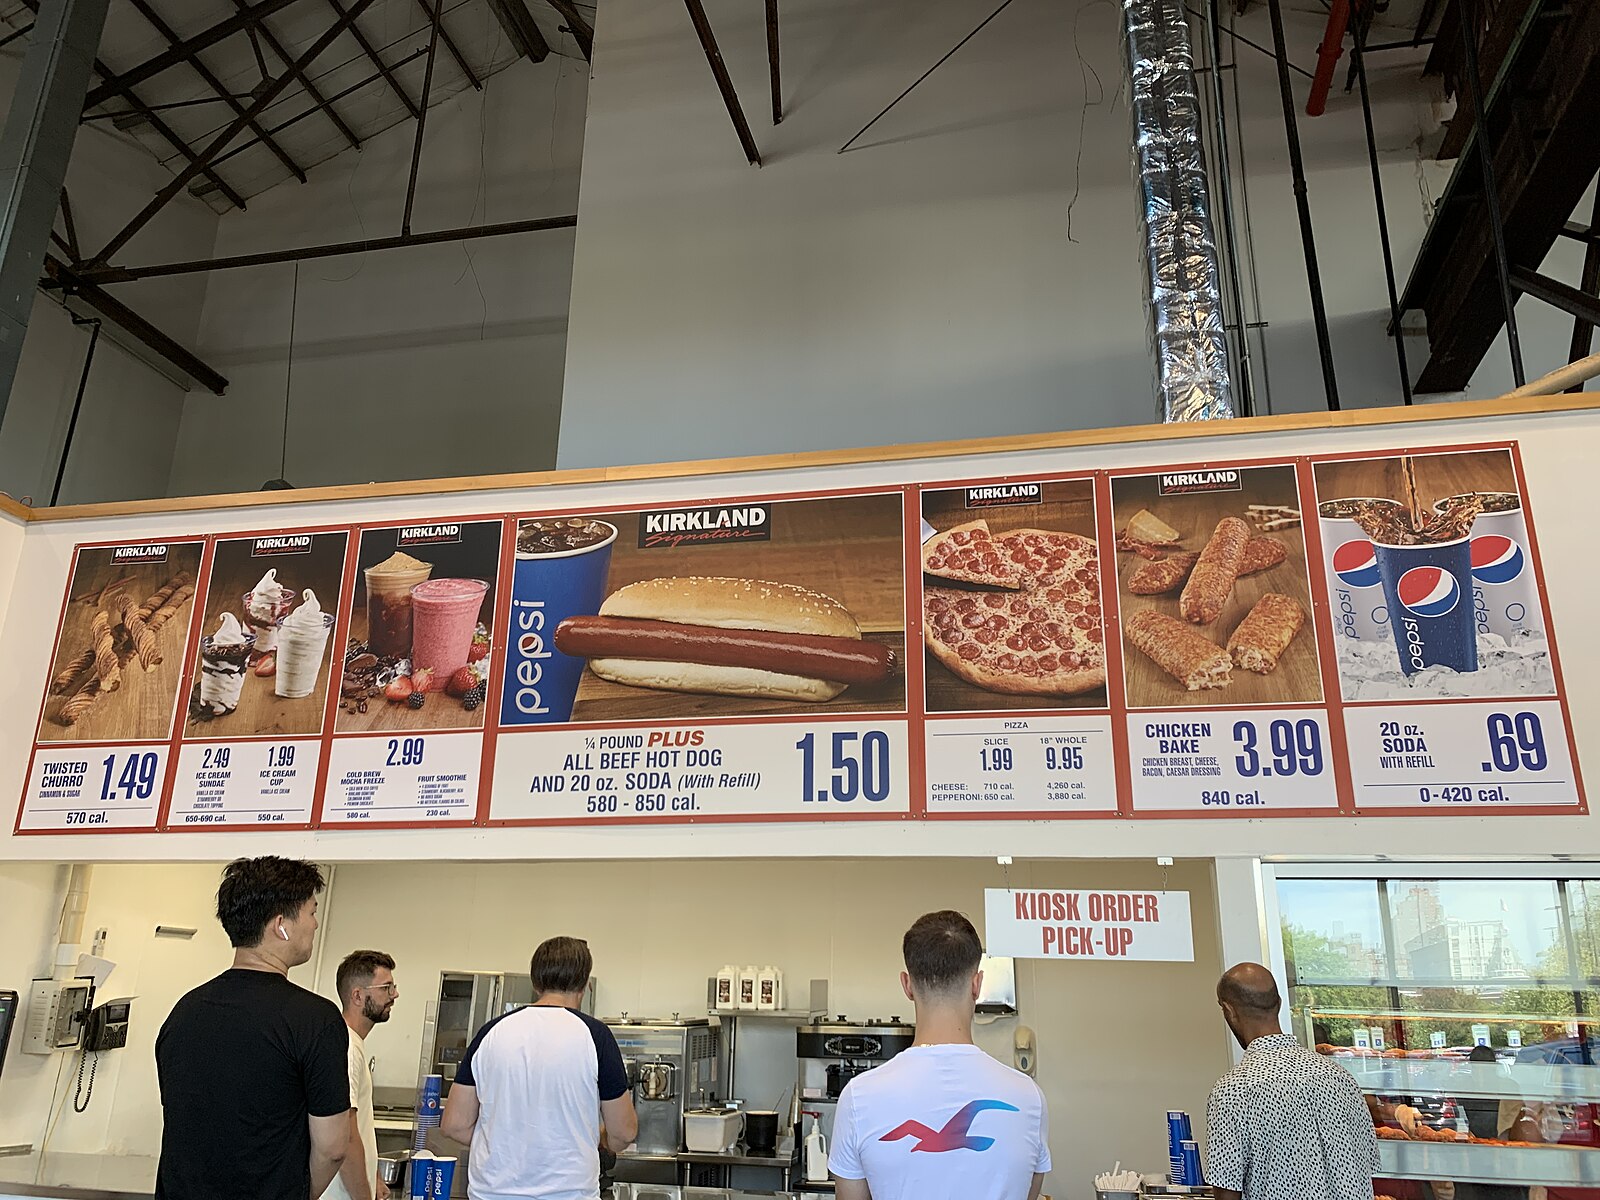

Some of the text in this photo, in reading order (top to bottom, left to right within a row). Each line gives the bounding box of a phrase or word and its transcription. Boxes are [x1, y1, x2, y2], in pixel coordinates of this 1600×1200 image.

[1163, 471, 1237, 486] KIRKLAND
[969, 485, 1039, 499] KIRKLAND
[646, 507, 766, 532] KIRKLAND
[401, 525, 459, 538] KIRKLAND
[645, 529, 765, 547] Signature
[256, 536, 310, 548] KIRKLAND
[115, 546, 166, 557] KIRKLAND
[1335, 588, 1360, 639] pepsi
[1401, 616, 1425, 671] pepsi
[513, 599, 552, 714] pepsi
[1004, 721, 1029, 729] PIZZA
[1145, 723, 1211, 738] CHICKEN
[1379, 721, 1424, 737] 20 oz.
[600, 735, 643, 749] POUND
[647, 730, 705, 748] PLUS
[1055, 736, 1088, 744] WHOLE
[1159, 739, 1200, 754] BAKE
[1383, 738, 1427, 753] SODA
[1481, 711, 1548, 773] .69
[386, 738, 425, 766] 2.99
[1232, 719, 1323, 777] 3.99
[202, 747, 231, 769] 2.49
[268, 746, 295, 767] 1.99
[563, 749, 722, 771] ALL BEEF HOT DOG
[979, 747, 1013, 771] 1.99
[1046, 746, 1083, 770] 9.95
[1142, 756, 1219, 767] CHICKEN BREAST, CHEESE,
[1380, 755, 1435, 769] WITH REFILL
[43, 762, 88, 774] TWISTED
[260, 769, 296, 778] ICE CREAM
[796, 730, 890, 802] 1.50
[1142, 767, 1221, 778] BACON, CAESAR DRESSING
[41, 775, 83, 788] CHURRO
[100, 752, 158, 800] 1.49
[207, 771, 231, 779] CREAM
[436, 774, 467, 782] SMOOTHIE
[530, 772, 761, 793] AND 20 oz. SODA (With Refill)
[199, 780, 225, 788] SUNDAE
[931, 783, 968, 791] CHEESE:
[1000, 782, 1014, 790] cal.
[1046, 782, 1069, 790] 4,260
[1070, 781, 1086, 789] cal.
[932, 793, 983, 801] PEPPERONI:
[984, 793, 999, 801] 650
[1047, 792, 1069, 801] 3,880
[1071, 792, 1086, 800] cal.
[1201, 790, 1265, 805] 840 cal.
[1478, 786, 1509, 802] cal.
[587, 794, 617, 812] 580
[635, 793, 665, 811] 850
[671, 793, 700, 811] cal.
[66, 811, 109, 824] 570 cal.
[185, 814, 227, 823] 650-690 cal.
[273, 813, 285, 821] cal.
[1014, 892, 1159, 922] KIOSK ORDER
[1042, 926, 1133, 956] PICK-UP
[434, 1169, 443, 1195] pepsi
